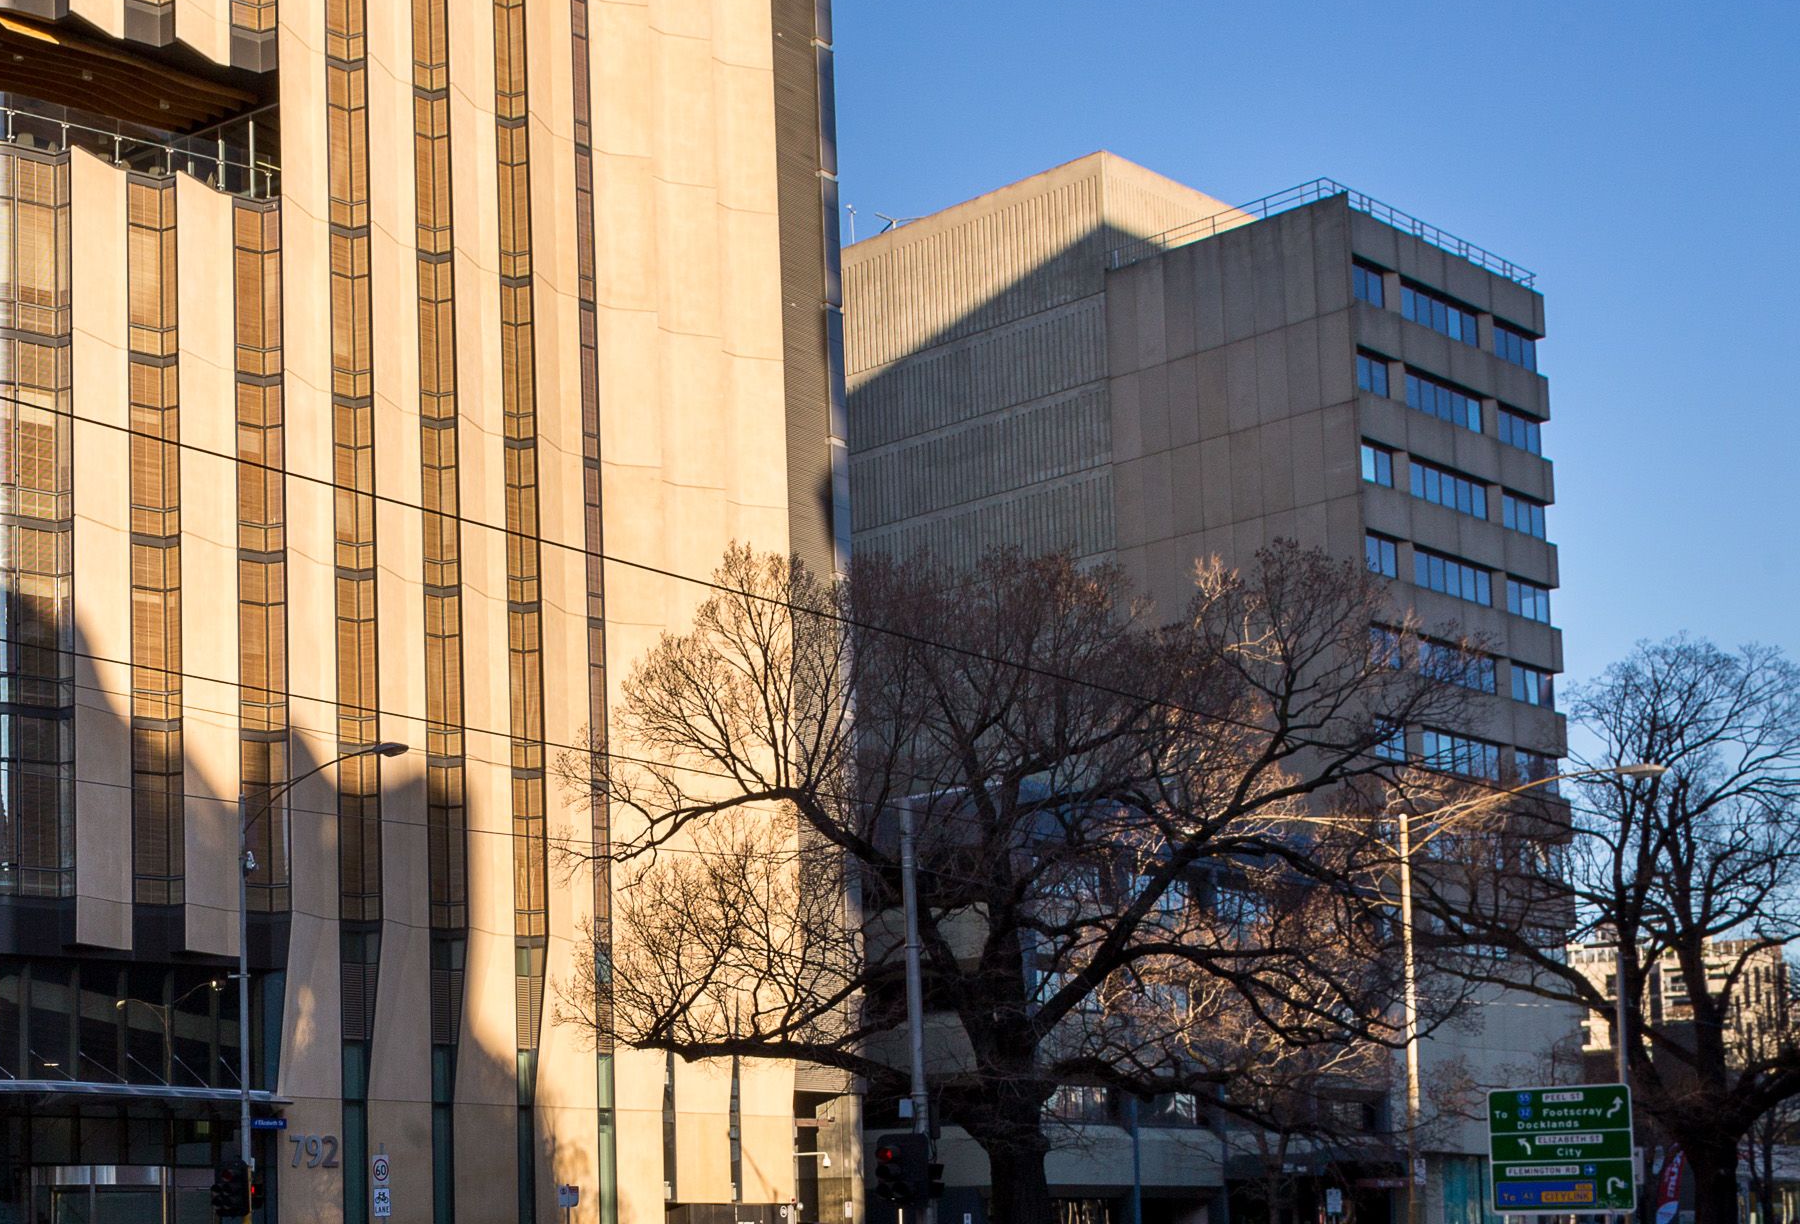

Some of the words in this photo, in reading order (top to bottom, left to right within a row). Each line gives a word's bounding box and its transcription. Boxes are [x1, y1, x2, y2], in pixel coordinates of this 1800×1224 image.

[1544, 1093, 1566, 1101] PEEL
[1569, 1092, 1581, 1100] ST
[1494, 1110, 1508, 1119] To
[1542, 1107, 1603, 1118] Footscray
[1517, 1120, 1580, 1130] Docklands
[1538, 1135, 1587, 1144] ELIZABETH
[1589, 1135, 1600, 1143] ST
[289, 1134, 339, 1168] 792
[1556, 1147, 1582, 1158] City
[375, 1164, 387, 1176] 60
[1508, 1167, 1562, 1175] FLEMINGTON
[1565, 1166, 1578, 1174] RD
[1544, 1191, 1590, 1201] CITYLINK
[375, 1206, 390, 1214] LANE
